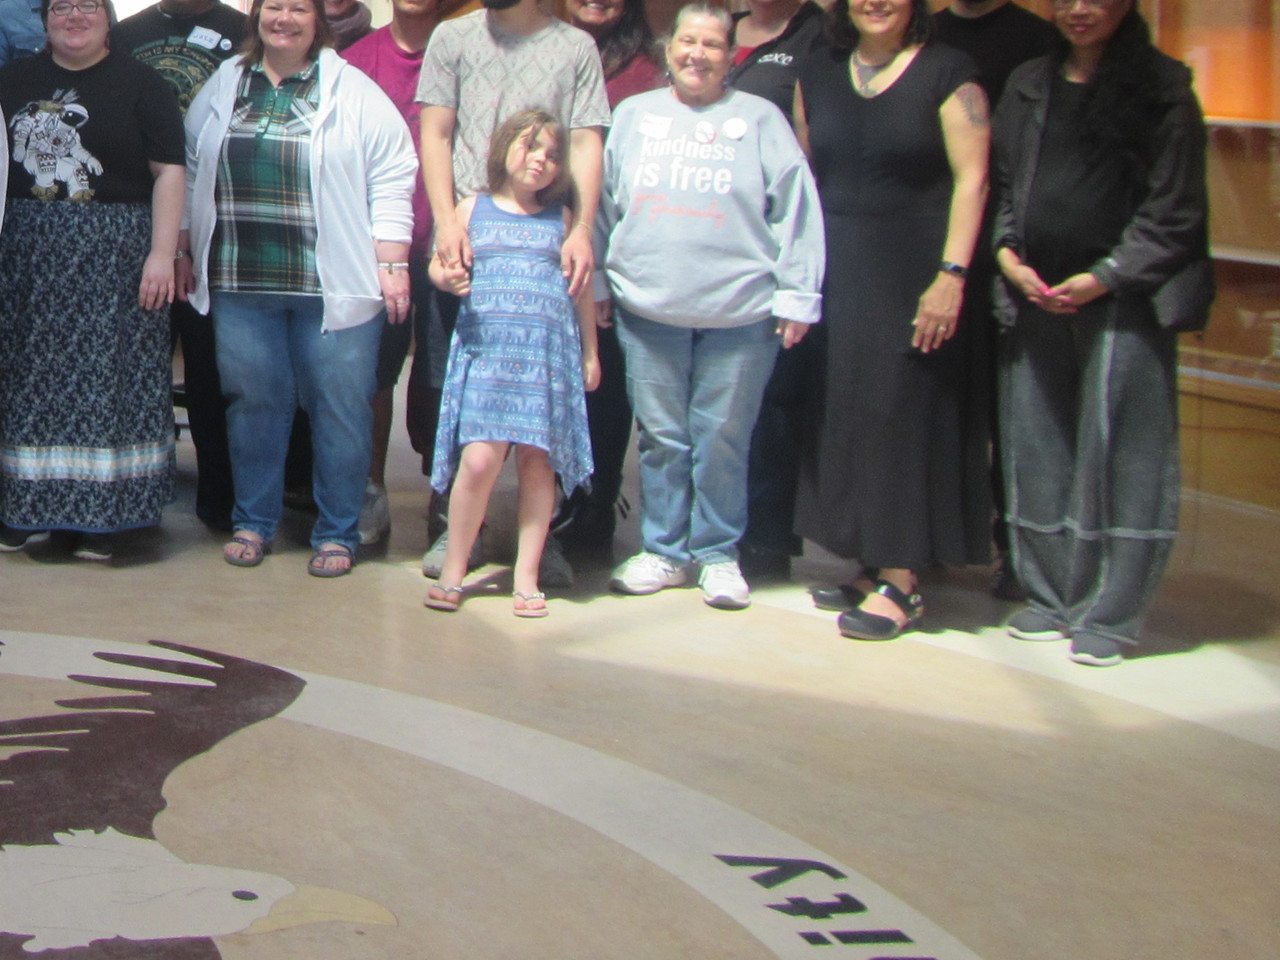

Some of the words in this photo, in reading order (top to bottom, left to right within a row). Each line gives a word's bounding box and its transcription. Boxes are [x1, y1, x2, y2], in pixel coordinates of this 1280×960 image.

[641, 134, 736, 161] kindness
[633, 157, 660, 188] is
[670, 156, 732, 194] free
